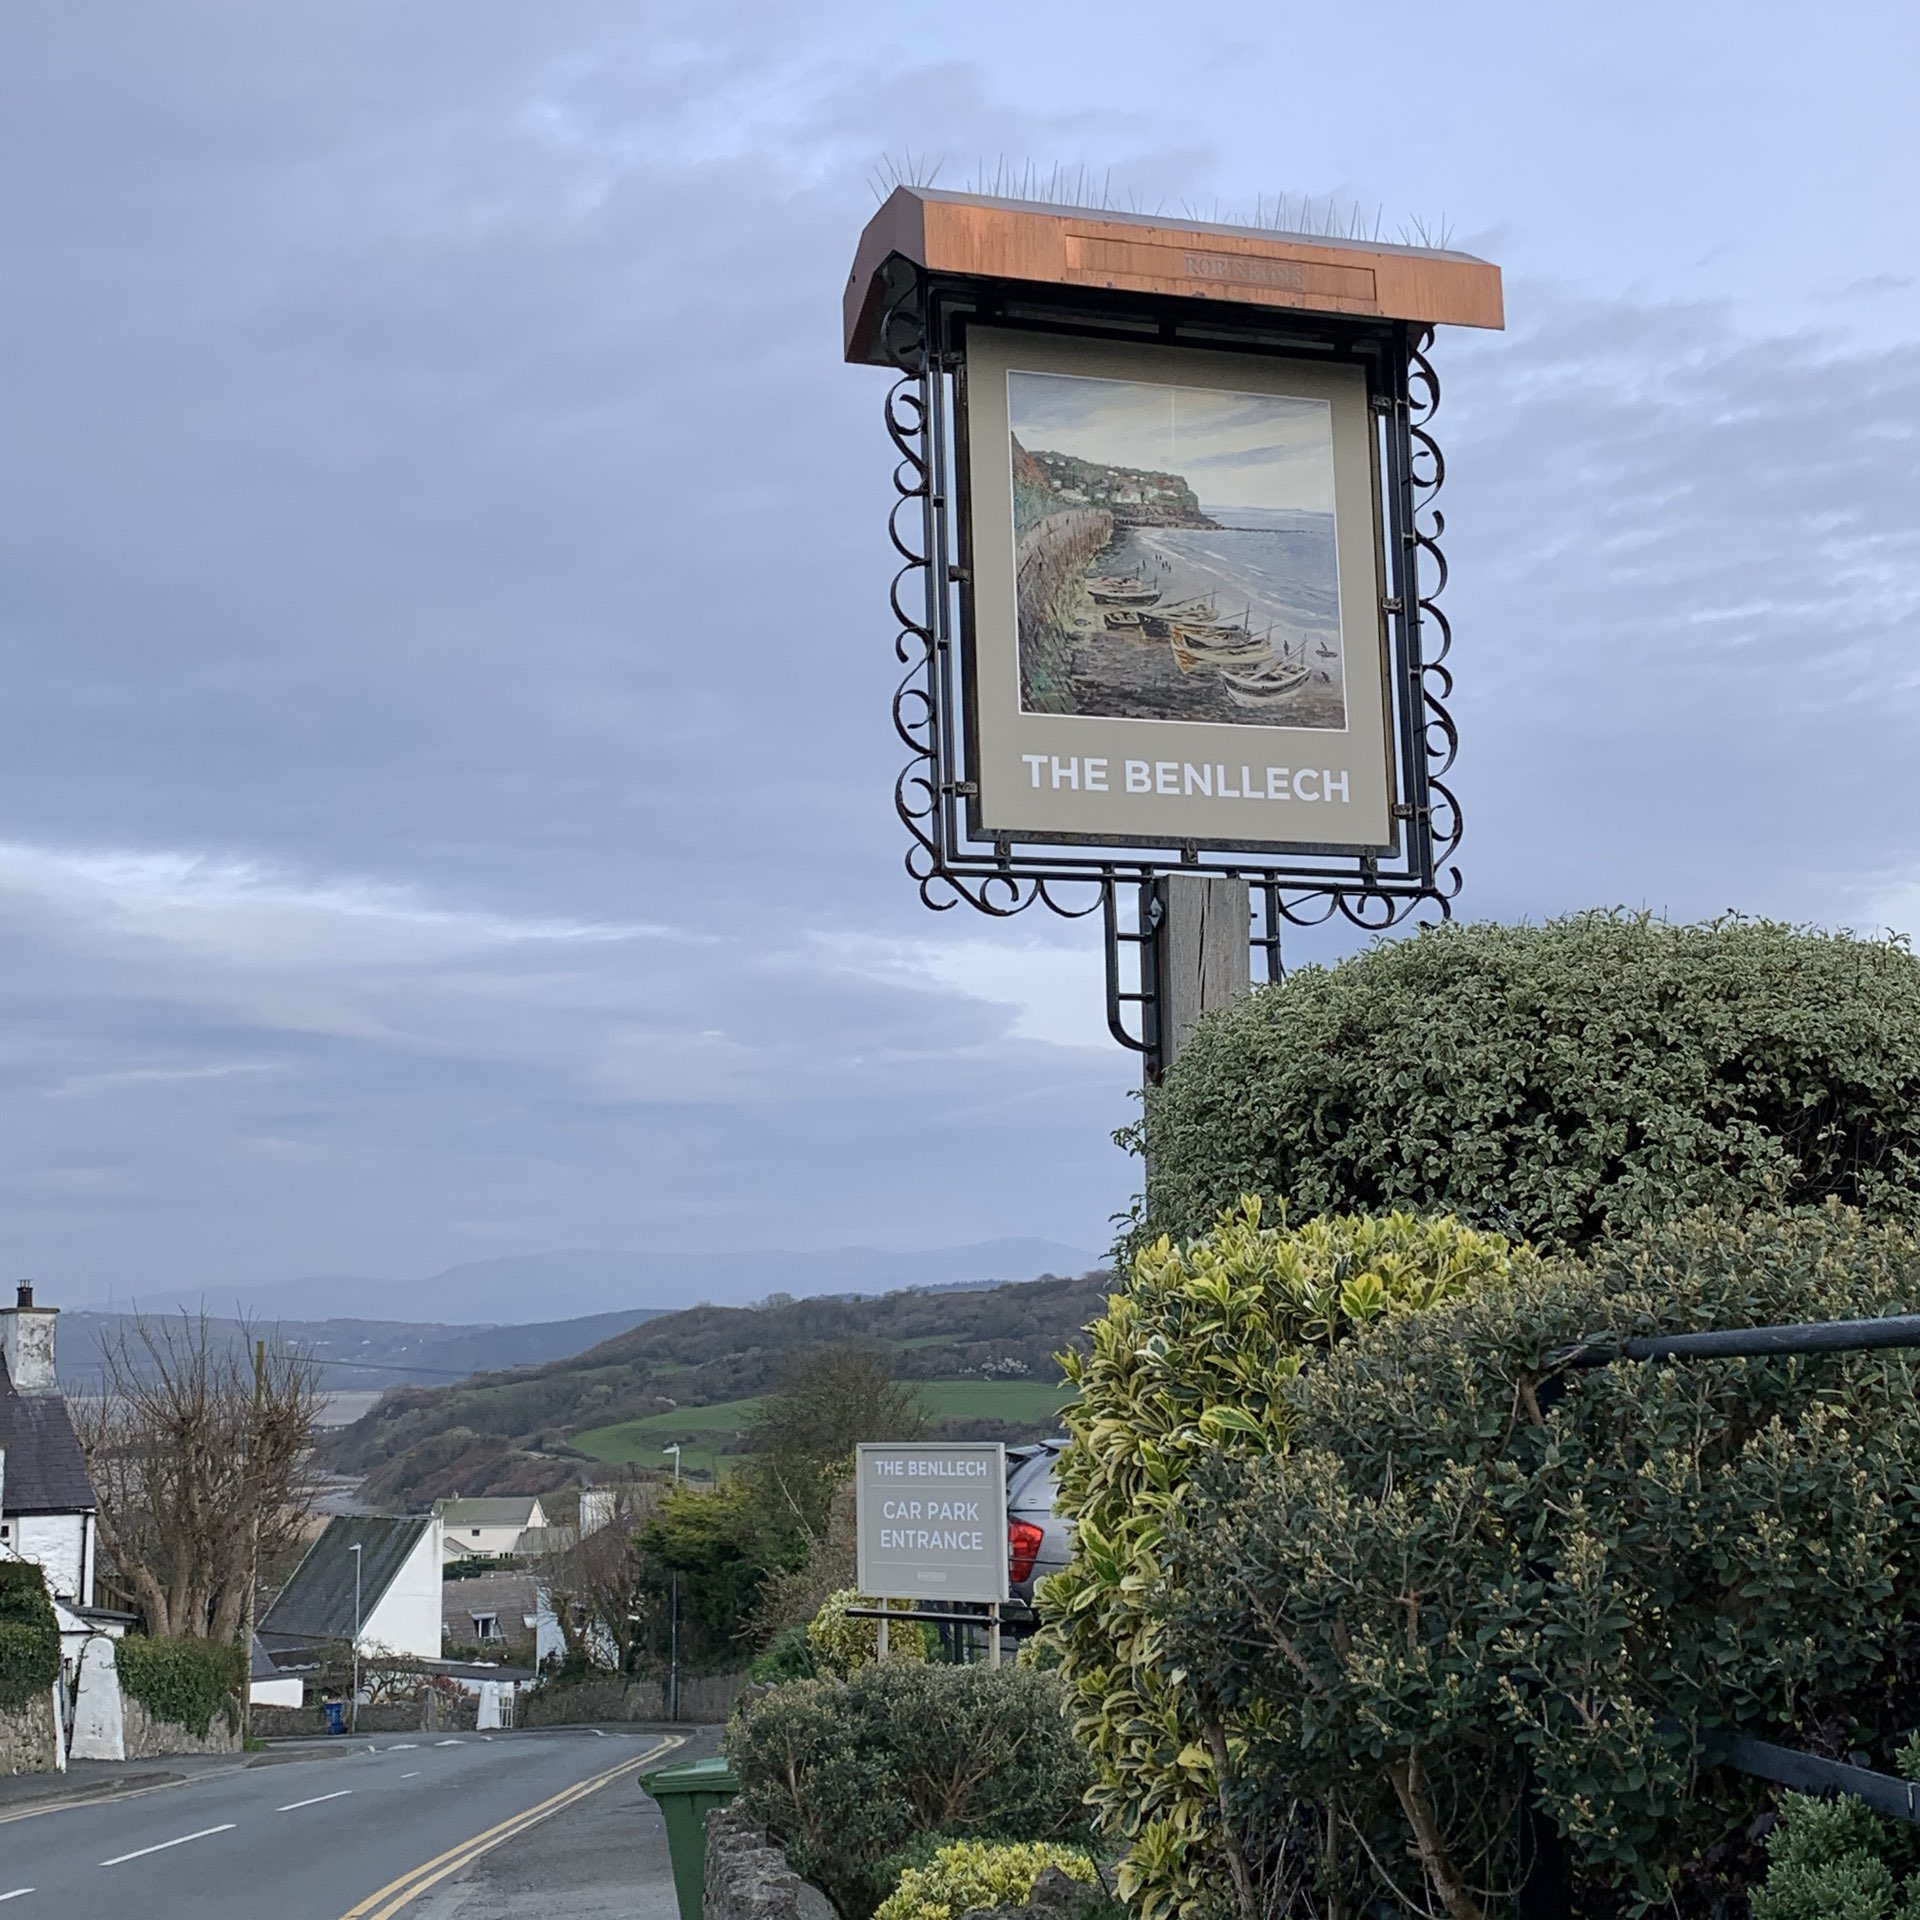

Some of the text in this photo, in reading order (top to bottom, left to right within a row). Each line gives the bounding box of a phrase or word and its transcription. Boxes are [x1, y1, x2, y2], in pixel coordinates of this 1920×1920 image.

[1022, 754, 1350, 803] THE BENLLECH
[875, 1460, 987, 1477] THE BENLLECH
[883, 1501, 980, 1521] CAR PARK
[880, 1529, 983, 1550] ENTRANCE
